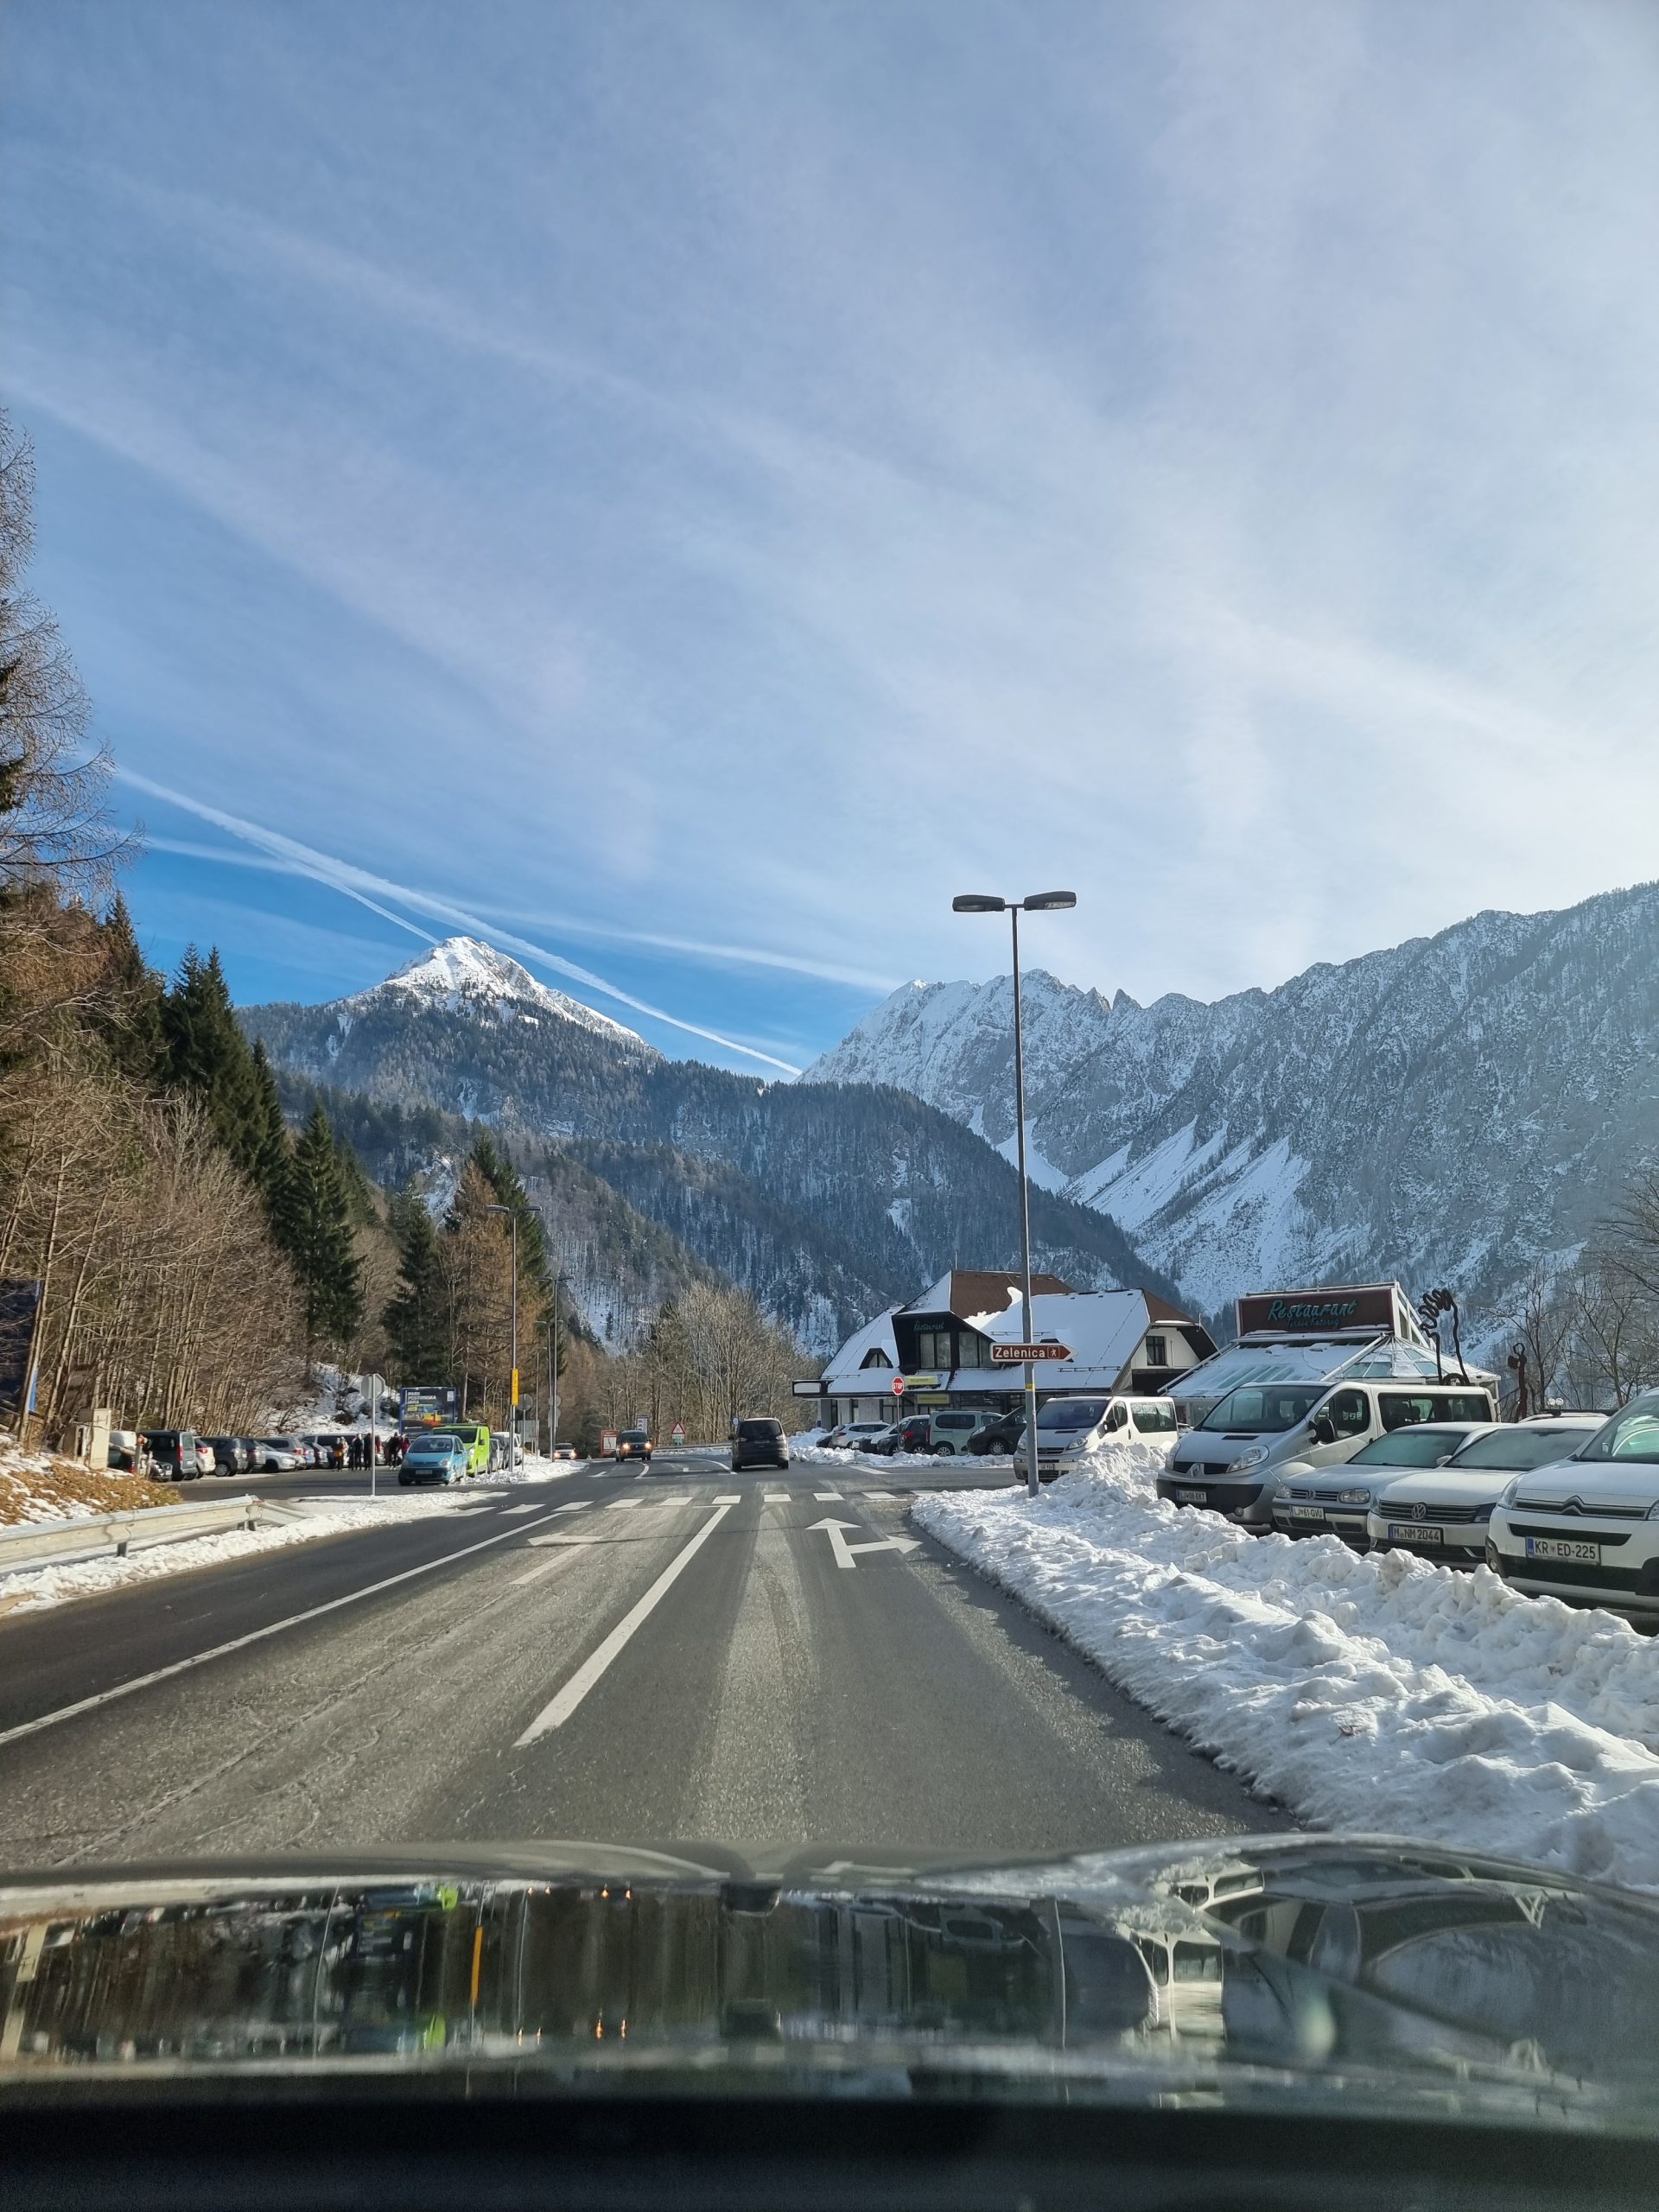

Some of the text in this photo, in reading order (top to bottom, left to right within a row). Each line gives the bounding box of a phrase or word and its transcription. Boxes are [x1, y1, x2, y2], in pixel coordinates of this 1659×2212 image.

[1268, 1300, 1358, 1320] Restaurant
[995, 1347, 1046, 1357] Zelenica
[1417, 1529, 1440, 1541] 2044
[1535, 1541, 1596, 1560] KR ED-225
